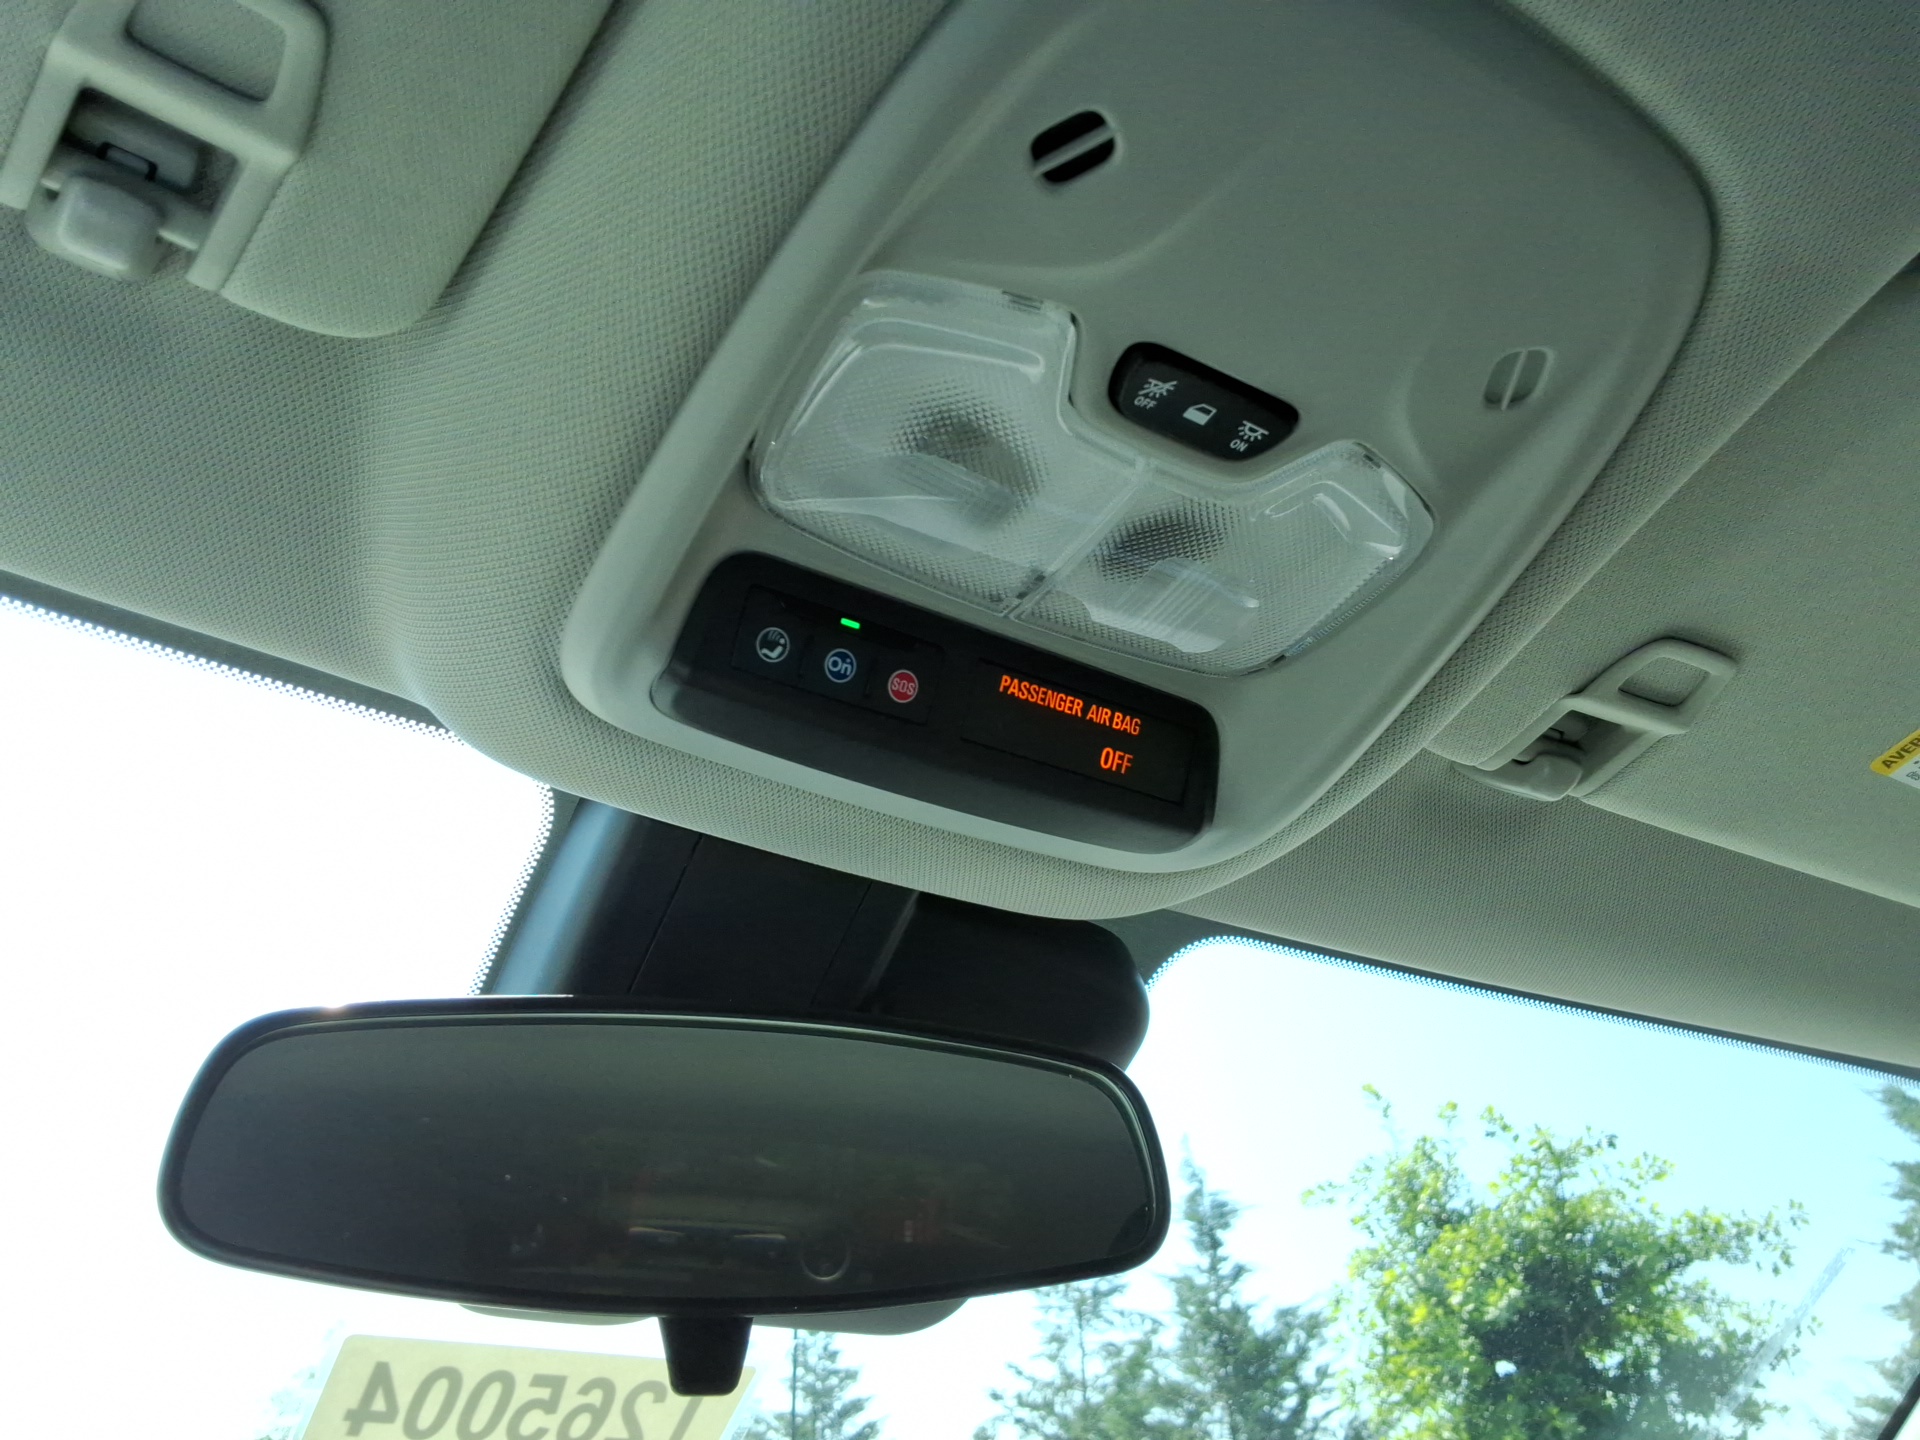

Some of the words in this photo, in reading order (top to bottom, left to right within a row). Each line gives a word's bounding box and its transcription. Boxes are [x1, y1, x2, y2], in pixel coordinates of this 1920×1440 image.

[1134, 396, 1158, 410] OFF
[1230, 439, 1248, 452] ON
[891, 677, 916, 696] SOS
[999, 674, 1084, 718] PASSENGER
[1086, 704, 1112, 727] AIR
[1112, 711, 1142, 736] BAG
[1100, 747, 1134, 774] OFF
